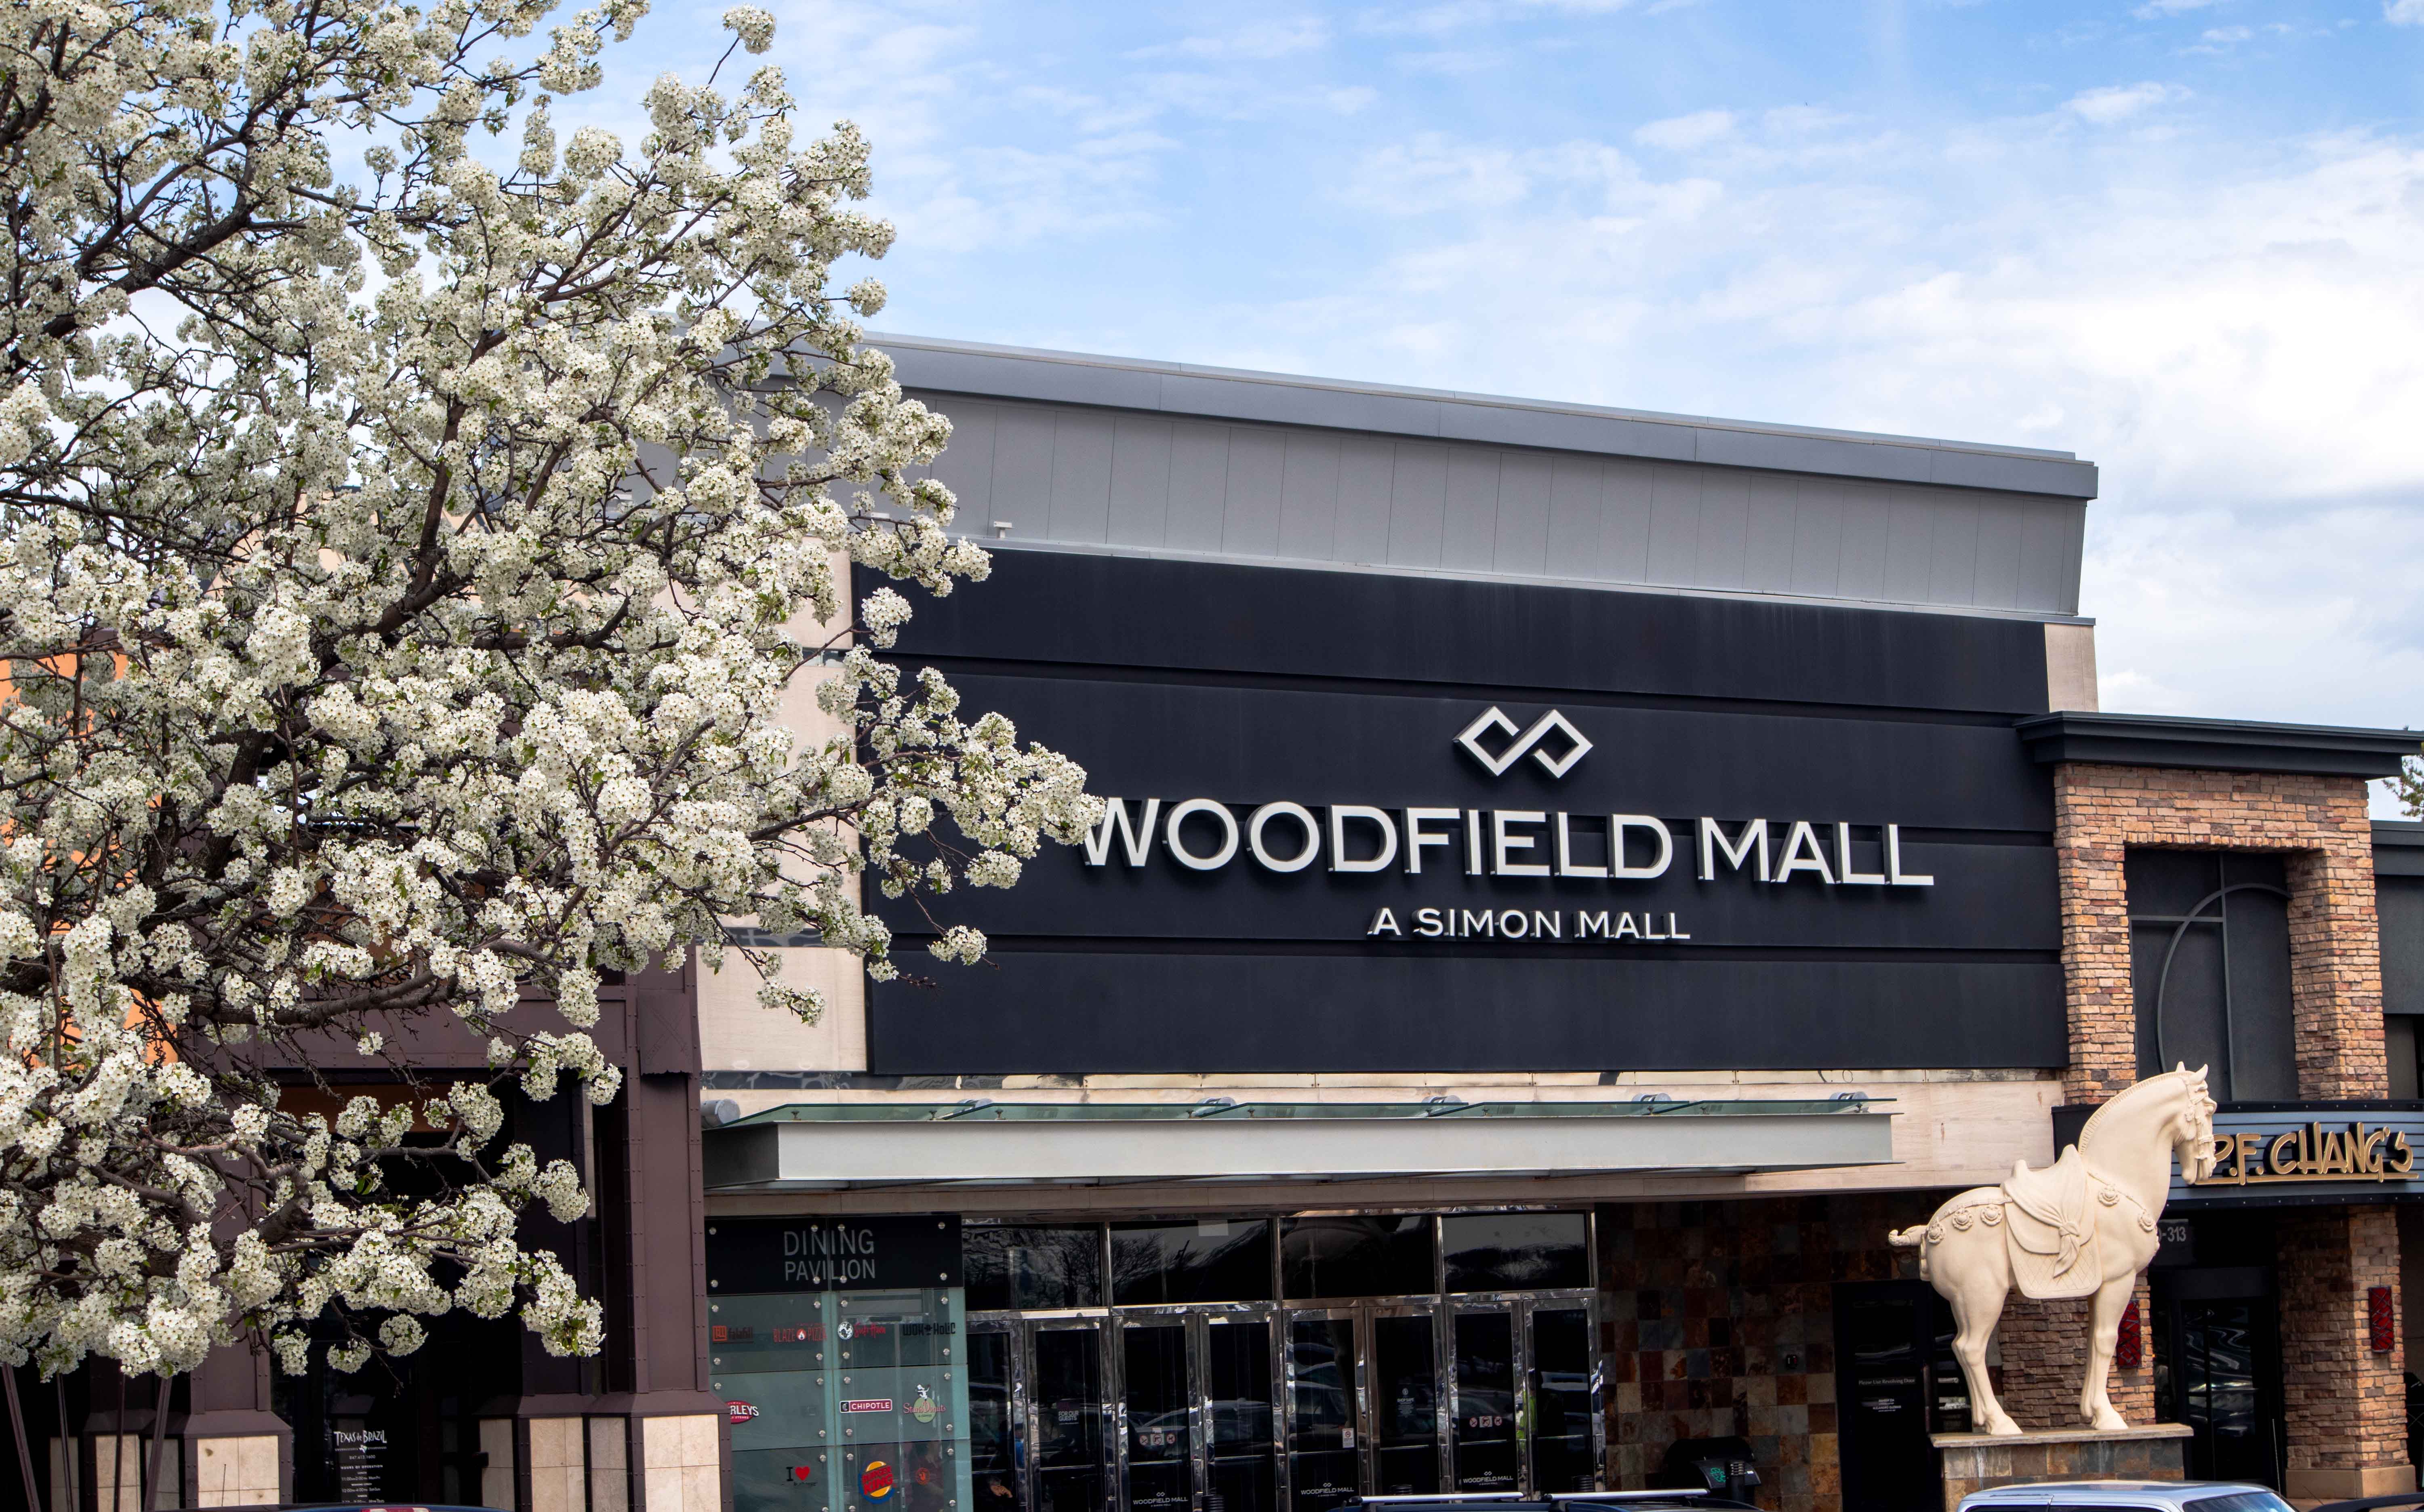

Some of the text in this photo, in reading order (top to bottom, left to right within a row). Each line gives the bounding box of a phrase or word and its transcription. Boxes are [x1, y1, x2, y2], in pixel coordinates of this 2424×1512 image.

[1084, 797, 1934, 885] WOODFIELD MALL
[1371, 908, 1691, 940] A SIMON MALL
[2270, 1121, 2414, 1183] CHANG'S
[783, 1229, 875, 1256] DINING
[785, 1259, 876, 1281] PAVILION
[772, 1327, 827, 1343] BLAZE PIZZA
[730, 1405, 760, 1416] RLEYS
[333, 1431, 356, 1447] TEXAS
[356, 1432, 363, 1441] de
[786, 1466, 793, 1482] I
[862, 1465, 892, 1483] BURGER
[864, 1473, 893, 1495] KING
